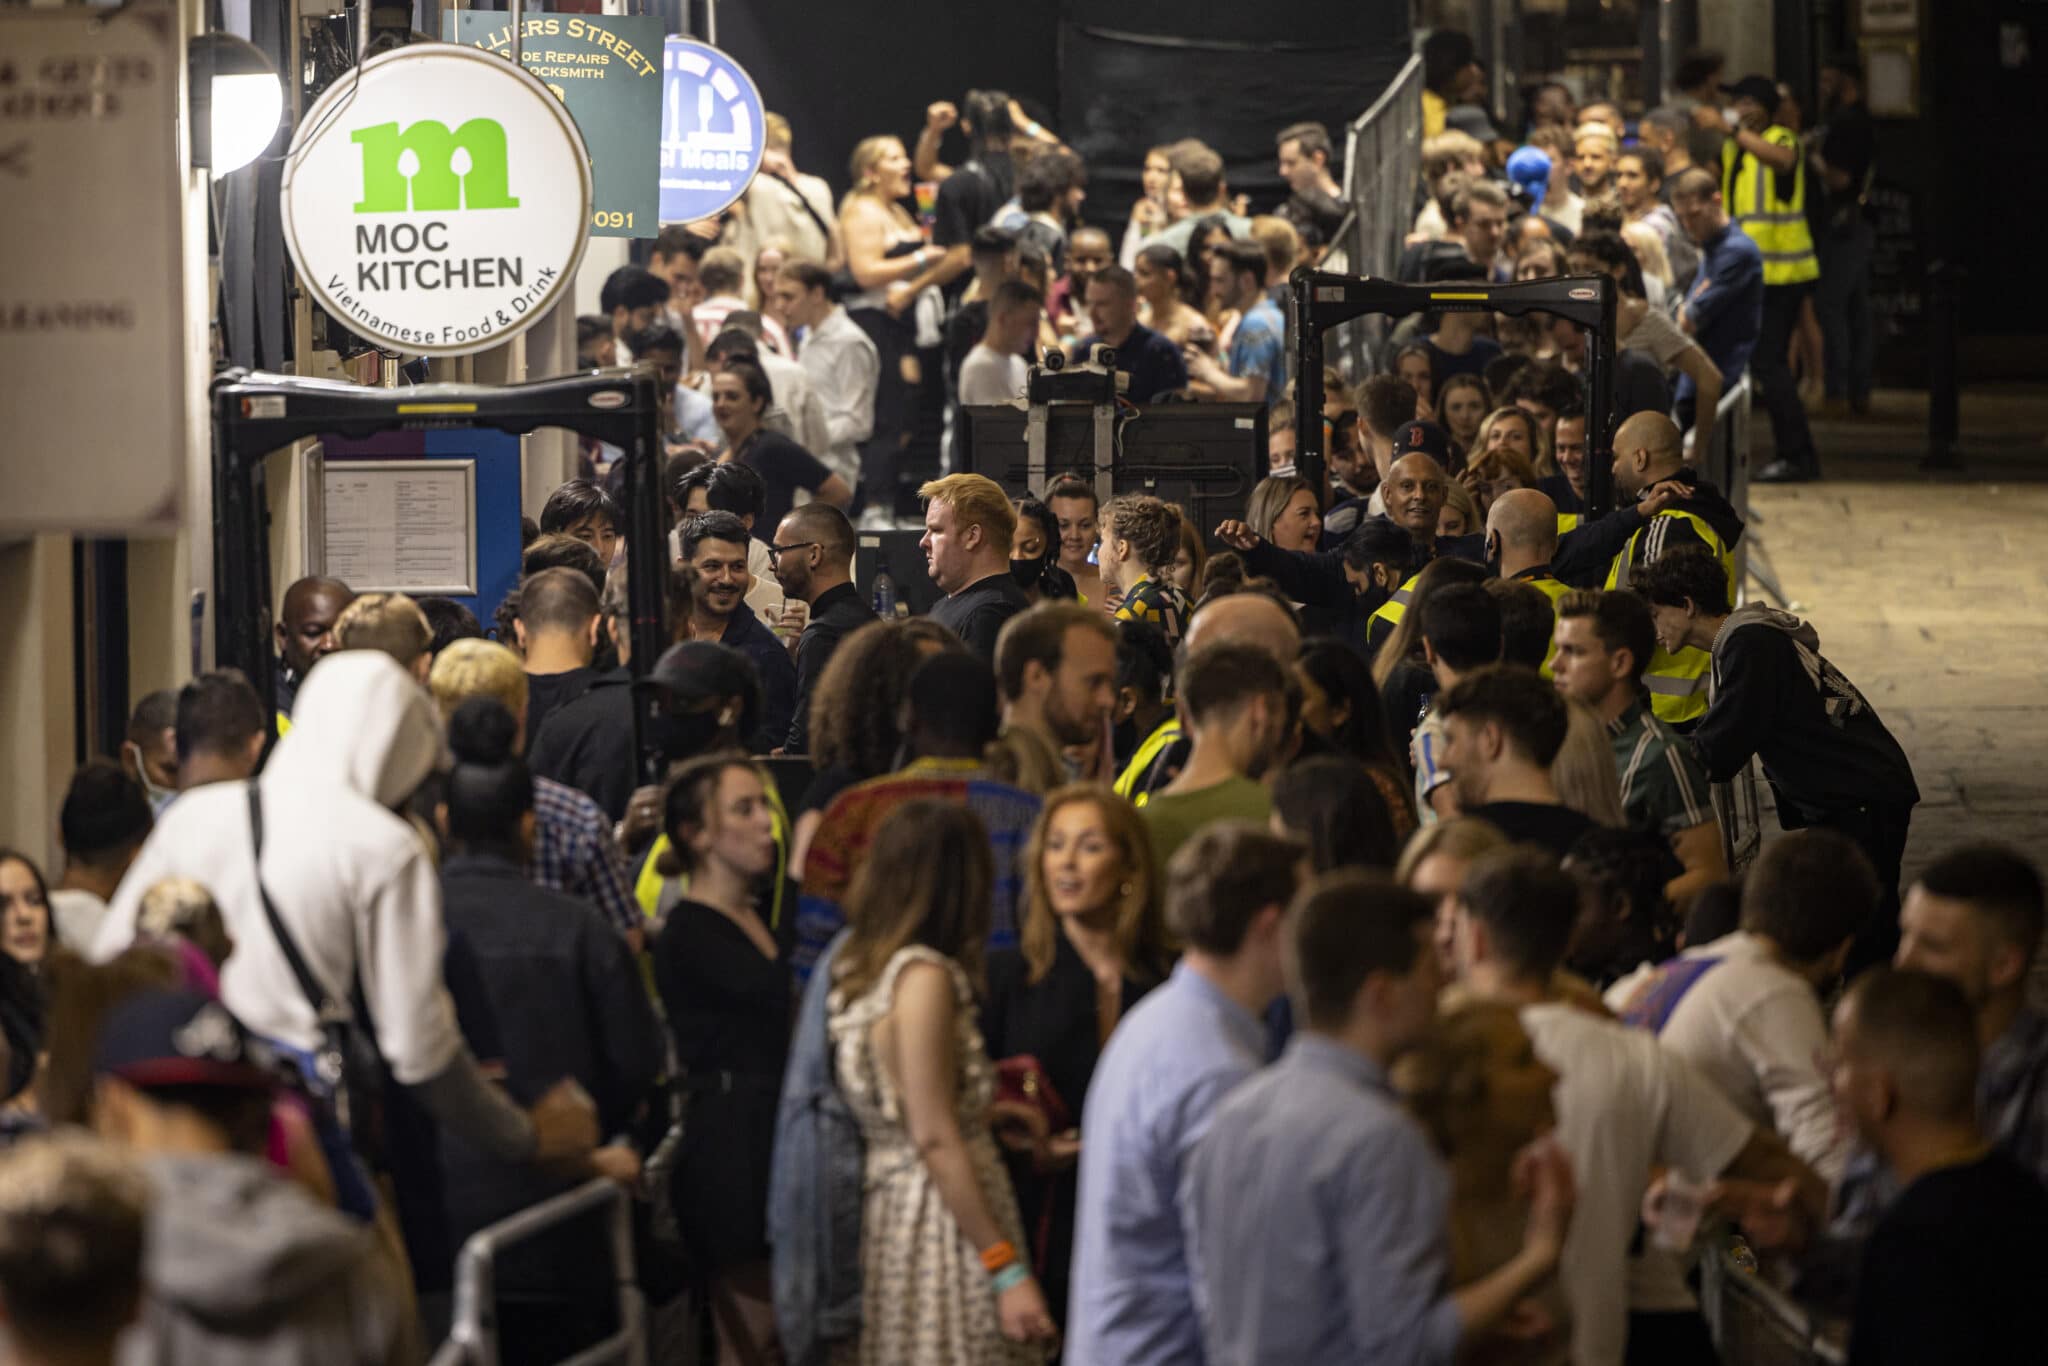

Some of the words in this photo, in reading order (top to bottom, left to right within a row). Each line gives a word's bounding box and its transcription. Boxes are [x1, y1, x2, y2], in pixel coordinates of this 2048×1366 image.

[475, 19, 560, 50] LLIERS
[566, 18, 656, 77] STREET
[500, 49, 541, 62] SOE
[545, 51, 610, 65] REPAIRS
[521, 64, 604, 79] OCKSMITH
[681, 149, 750, 171] Meals
[591, 210, 633, 228] 091
[356, 222, 449, 254] MOC
[357, 257, 523, 292] KITCHEN
[328, 274, 435, 344] Vietnamese
[443, 316, 491, 343] Food
[495, 310, 512, 326] &
[511, 266, 557, 314] Drink
